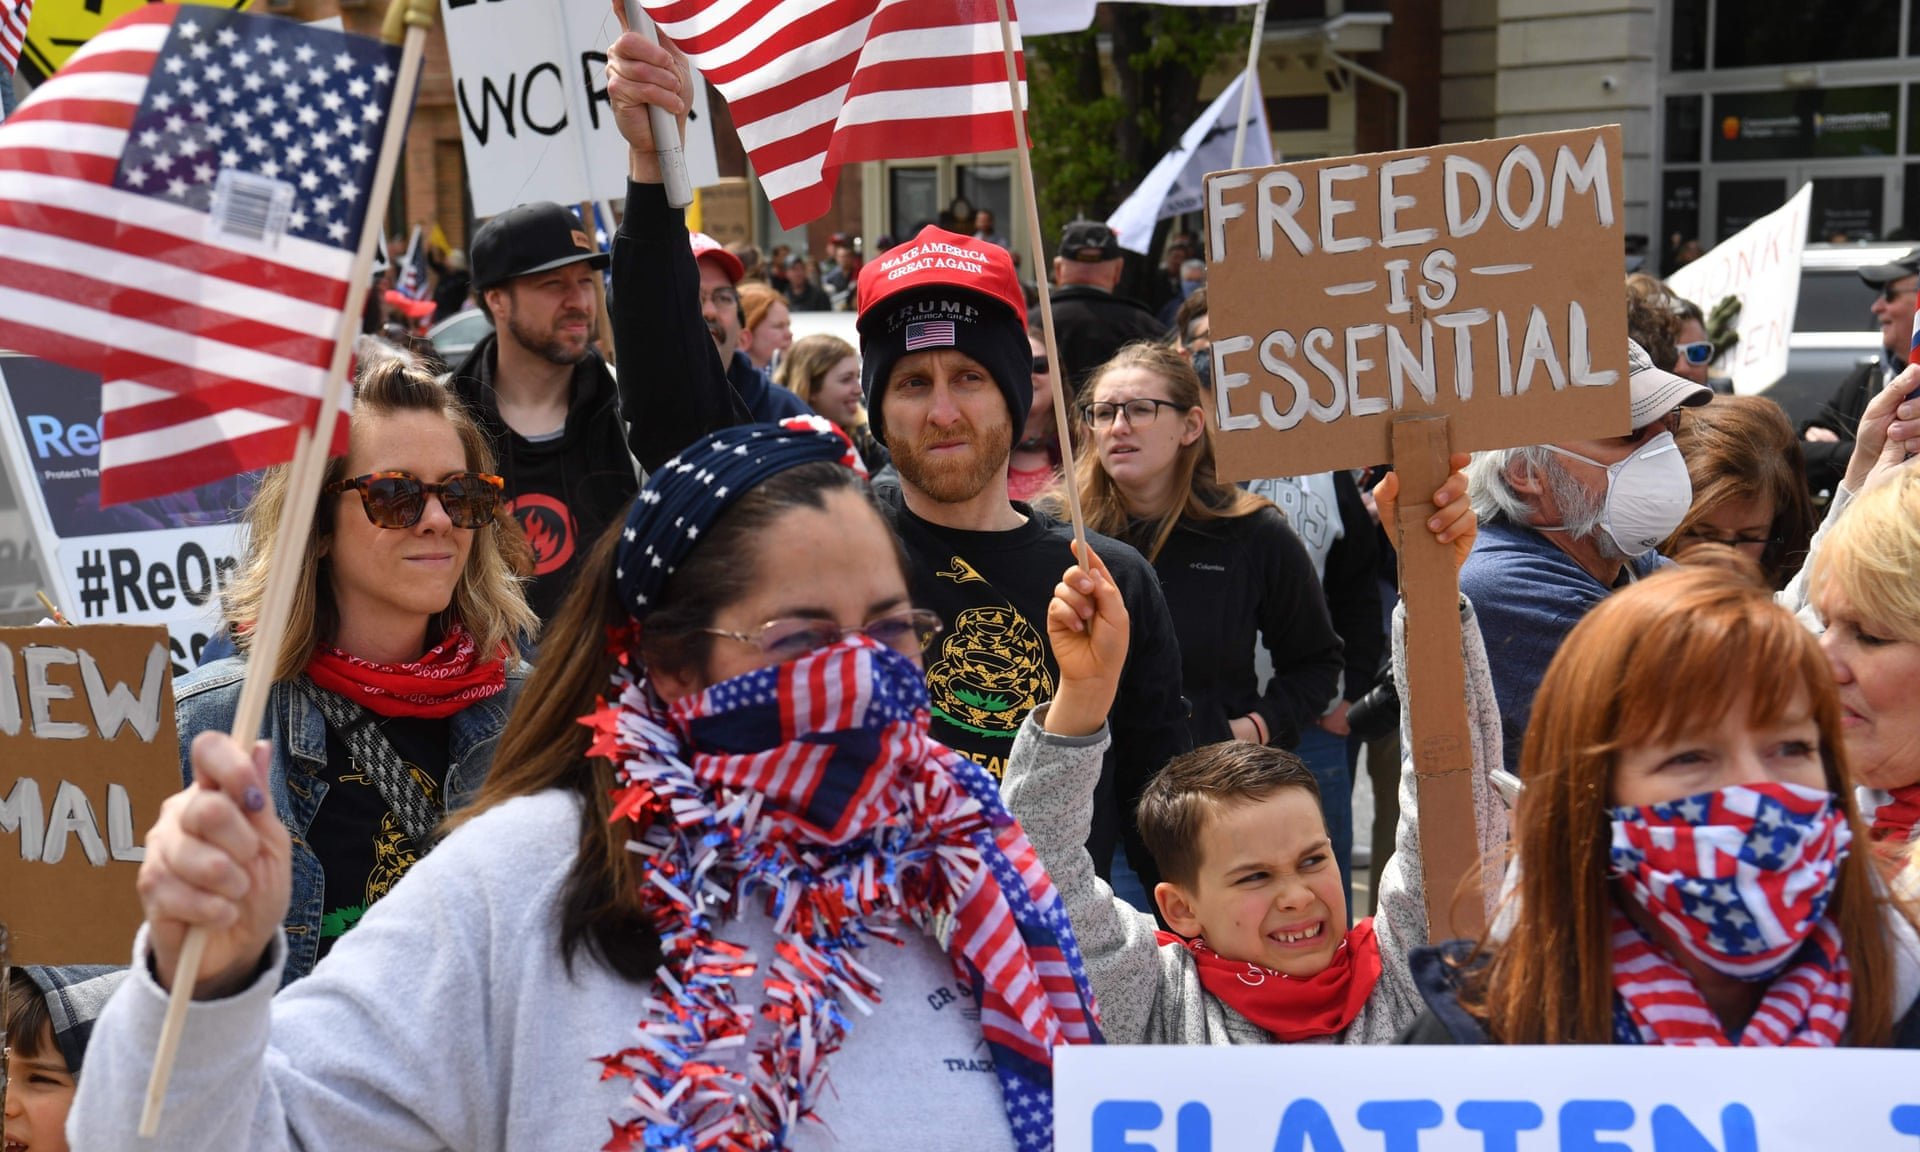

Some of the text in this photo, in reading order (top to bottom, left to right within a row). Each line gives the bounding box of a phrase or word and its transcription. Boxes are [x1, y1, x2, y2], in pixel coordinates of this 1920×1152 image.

[458, 50, 697, 147] WOR
[1206, 136, 1614, 263] FREEDOM
[880, 242, 990, 272] MAKE AMERICA
[887, 258, 982, 281] GREAT AGAIN
[1384, 248, 1458, 314] IS
[886, 300, 979, 325] TRUMP
[907, 313, 943, 322] AMERICA
[1211, 301, 1620, 432] ESSENTIAL
[27, 414, 104, 458] Re
